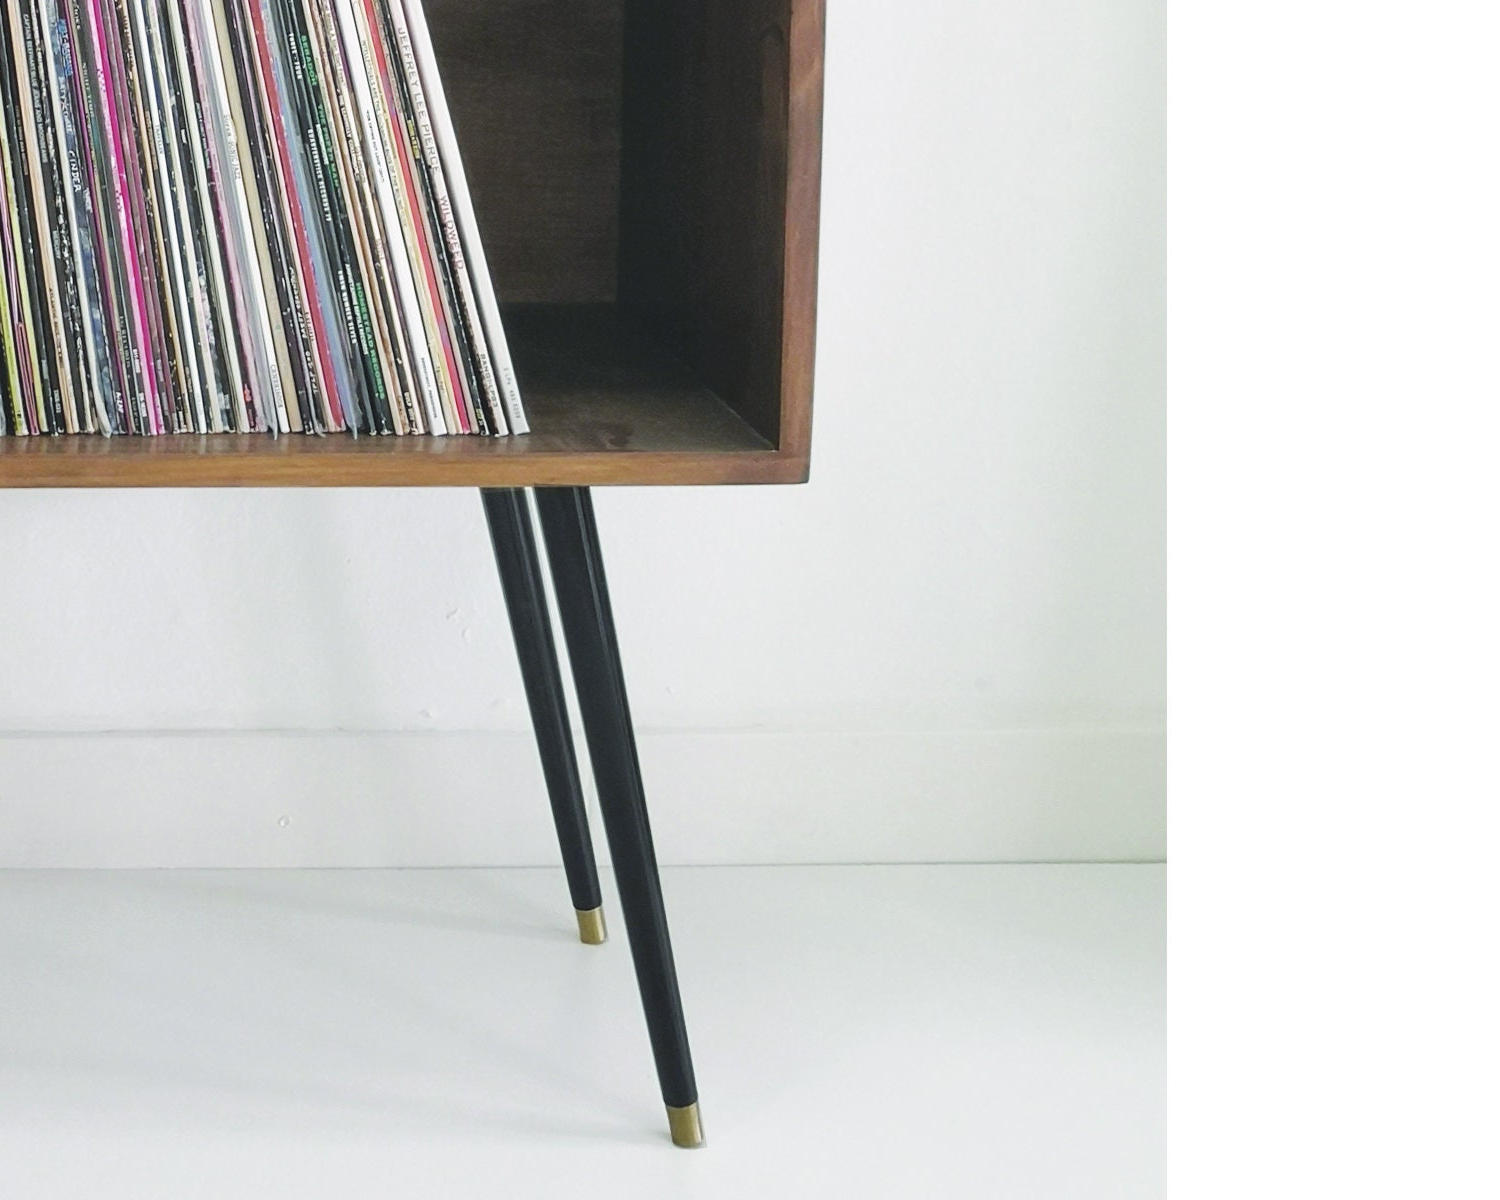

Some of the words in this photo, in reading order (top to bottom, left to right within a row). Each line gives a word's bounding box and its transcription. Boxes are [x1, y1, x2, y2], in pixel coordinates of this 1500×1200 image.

[396, 27, 420, 87] JEFFREY
[412, 92, 428, 121] LEE
[67, 149, 81, 192] CINDER
[419, 123, 441, 175] PIERCE
[316, 104, 326, 121] THE
[354, 282, 374, 348] HOMESTEAD
[368, 349, 386, 400] RECORDS
[436, 195, 466, 270] WILDWEED
